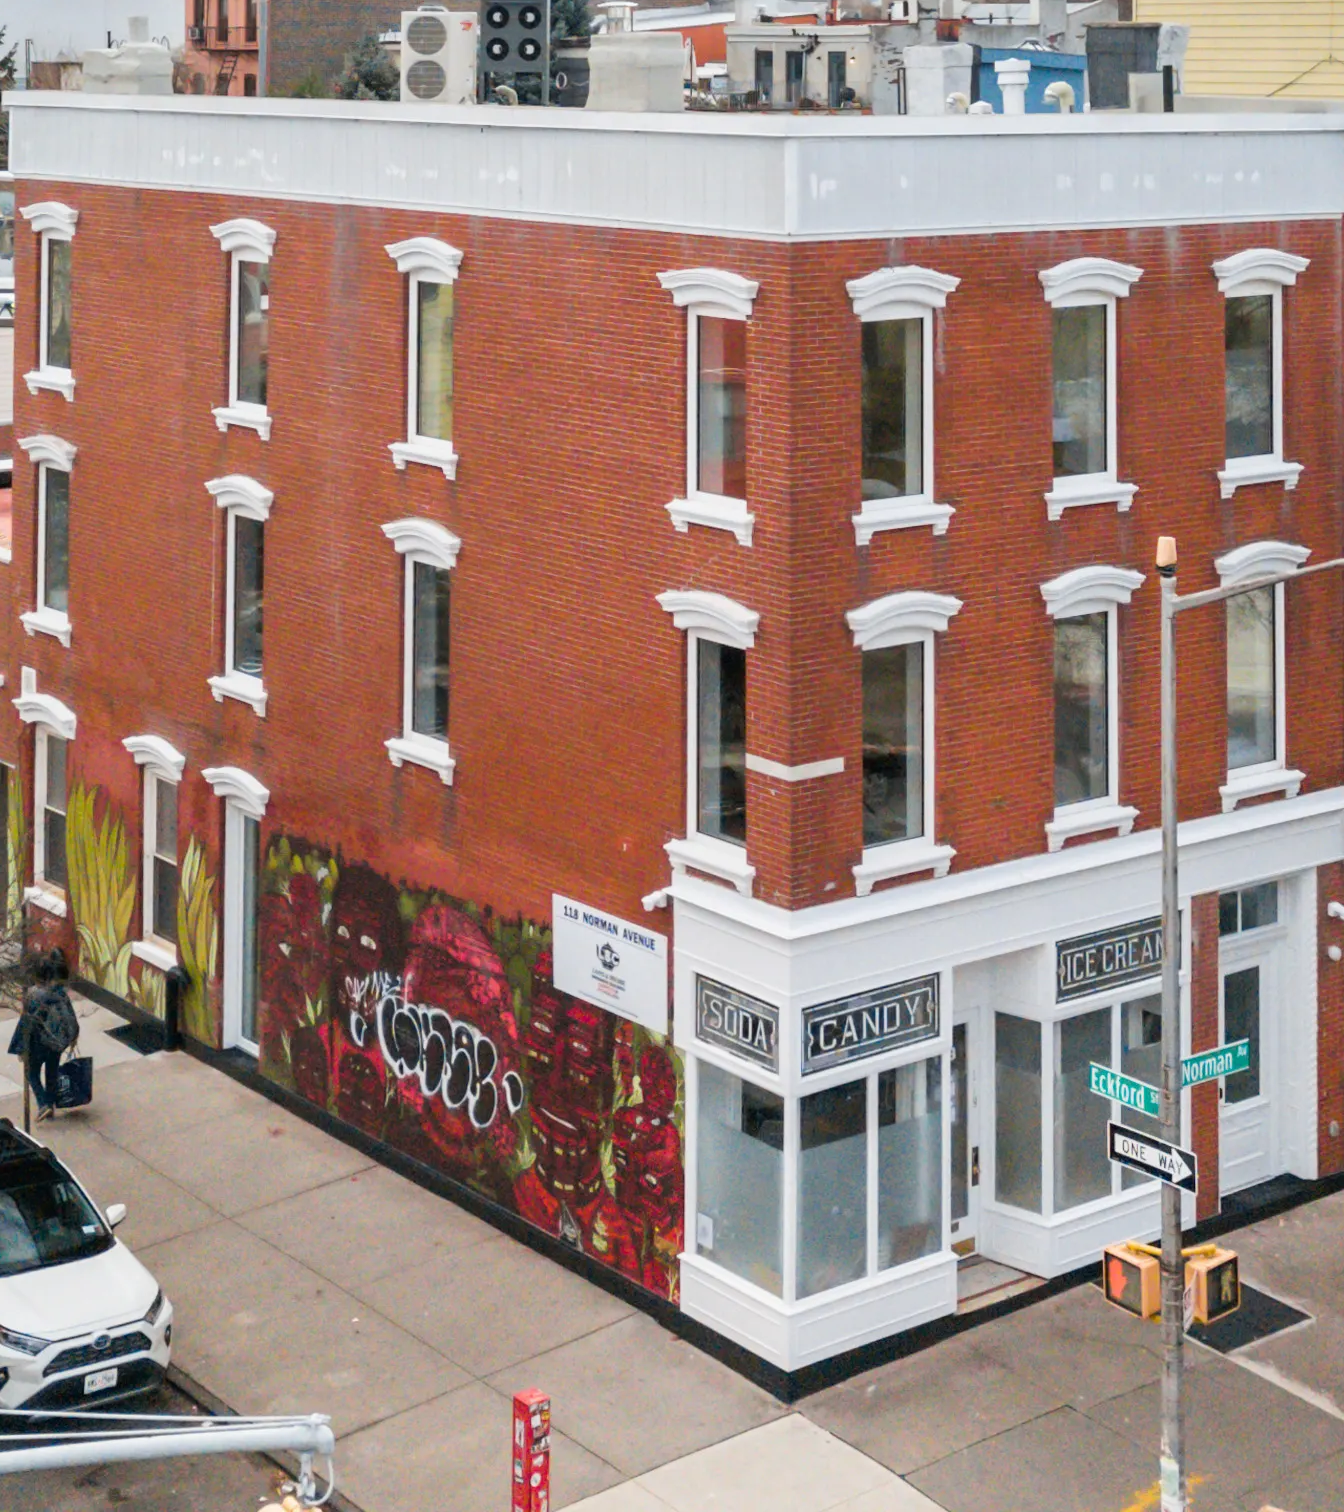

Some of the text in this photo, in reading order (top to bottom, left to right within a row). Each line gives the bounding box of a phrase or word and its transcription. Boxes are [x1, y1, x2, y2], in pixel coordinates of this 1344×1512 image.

[564, 905, 655, 950] 118 NORMAN AVENUE
[1066, 949, 1096, 982] ICE
[710, 999, 767, 1051] SODA
[819, 996, 920, 1050] CANDY
[1182, 1052, 1233, 1083] Norman
[1091, 1068, 1145, 1109] Eckford
[1122, 1140, 1183, 1175] ONE WAY
